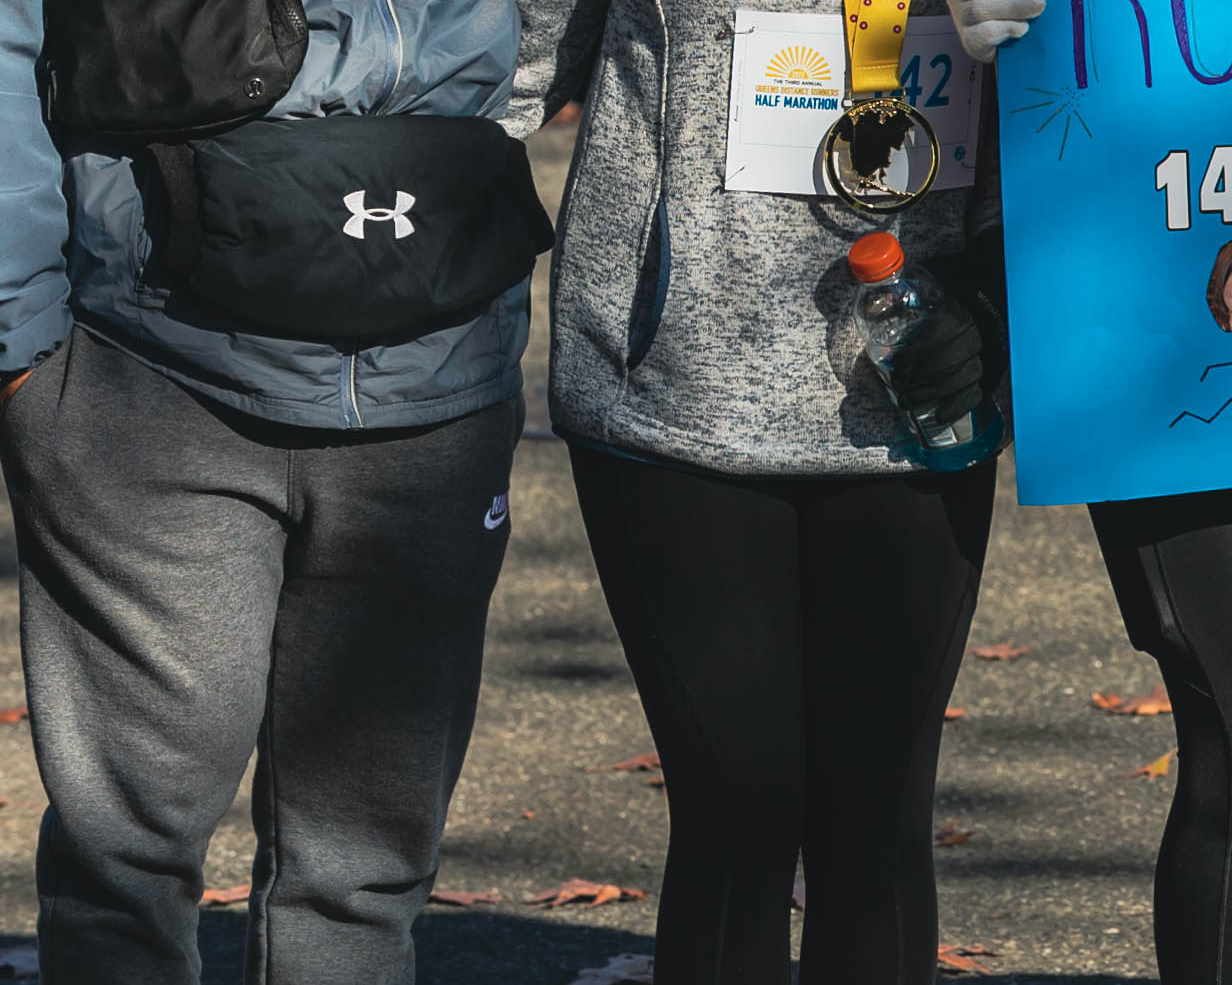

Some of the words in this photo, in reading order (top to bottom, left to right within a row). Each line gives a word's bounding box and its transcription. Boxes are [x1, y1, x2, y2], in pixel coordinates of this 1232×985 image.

[874, 54, 952, 107] 42
[755, 94, 780, 107] HALF
[783, 96, 838, 110] MARATHON
